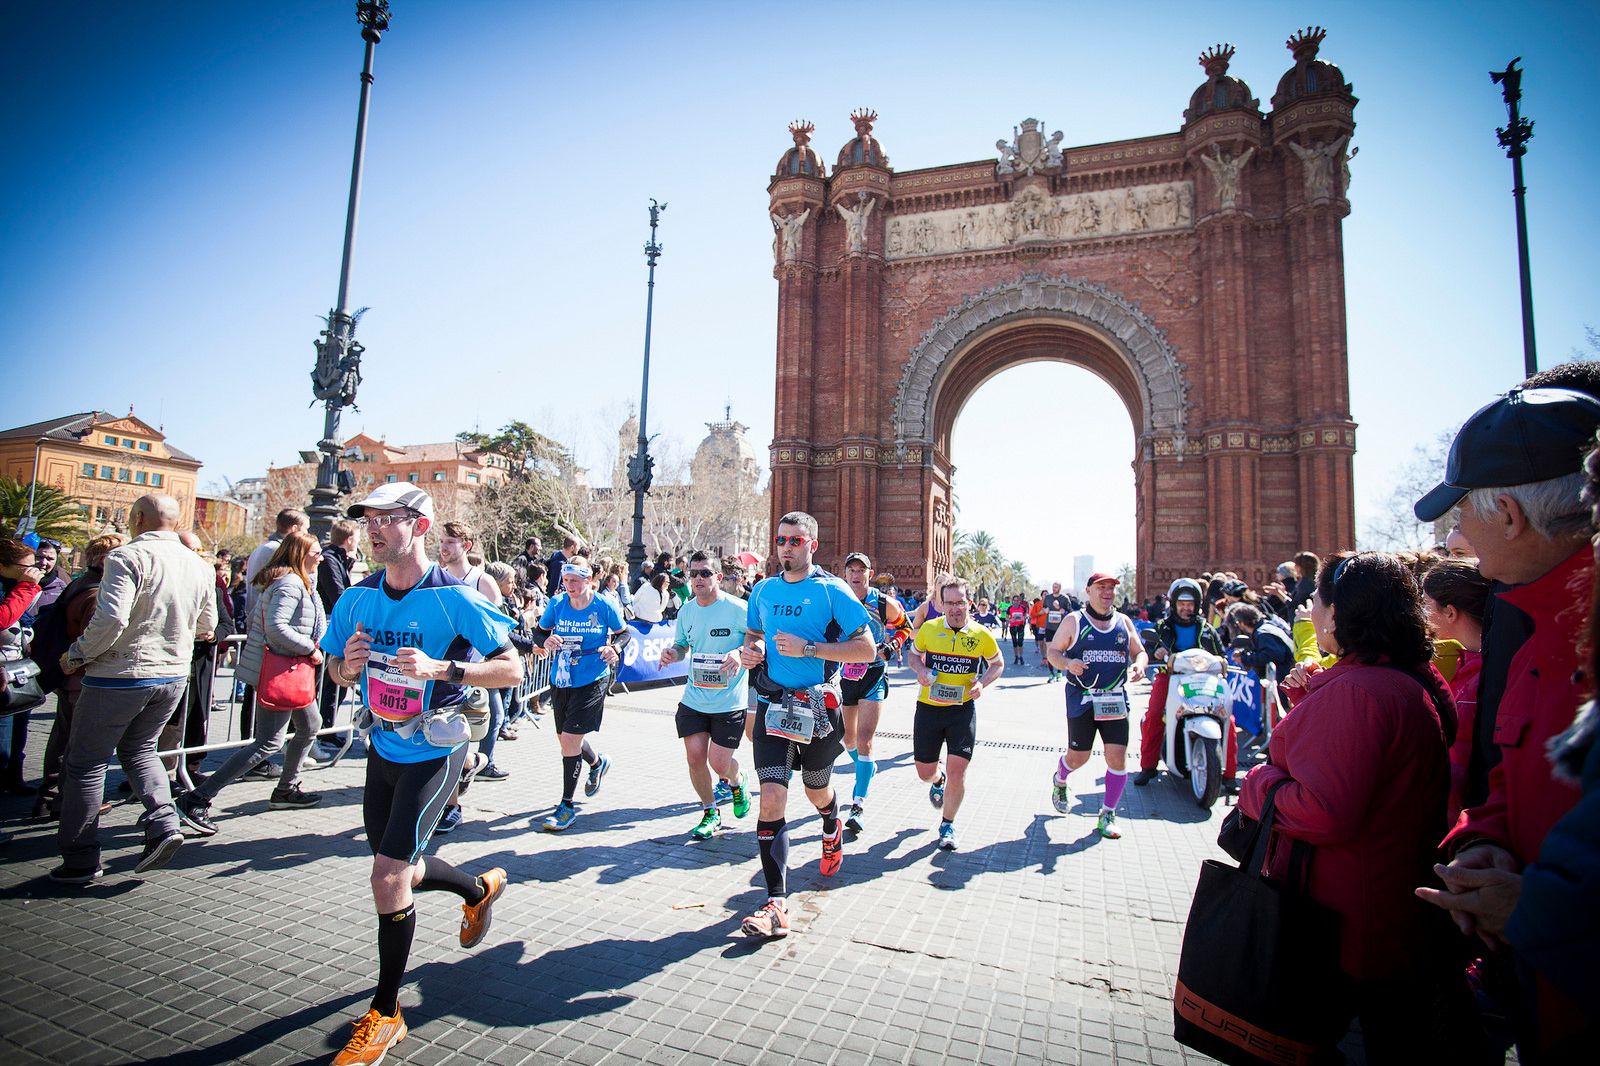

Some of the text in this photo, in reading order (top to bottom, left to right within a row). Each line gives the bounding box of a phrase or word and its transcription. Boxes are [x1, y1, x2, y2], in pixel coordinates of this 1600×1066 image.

[931, 654, 972, 664] CLUB CICLISTA
[932, 662, 970, 674] ALCAÑIZ
[379, 693, 408, 711] 14013
[780, 718, 803, 732] 9244
